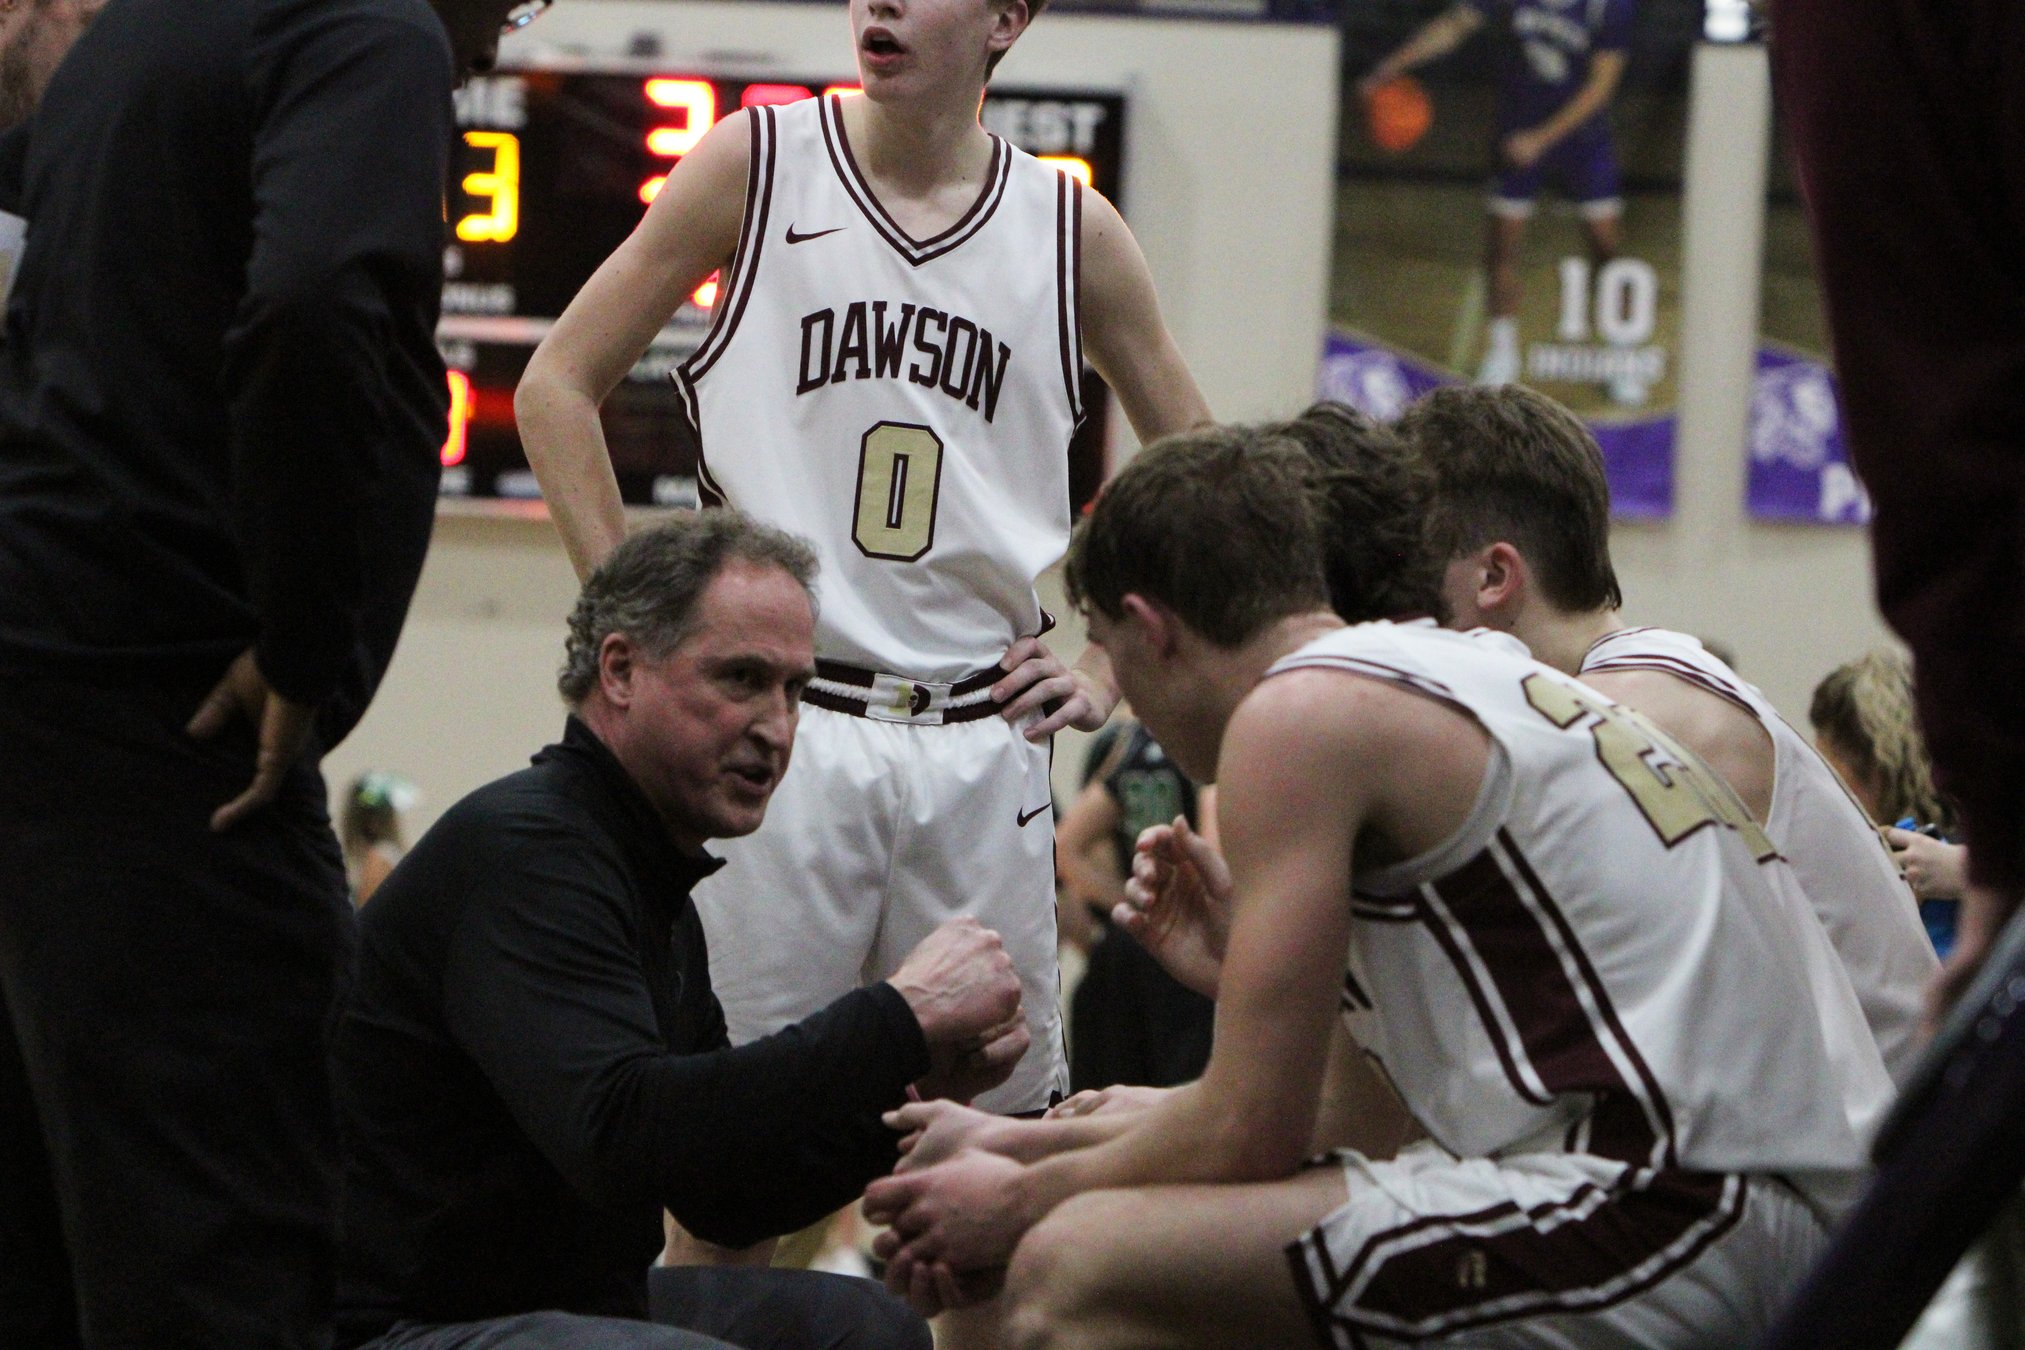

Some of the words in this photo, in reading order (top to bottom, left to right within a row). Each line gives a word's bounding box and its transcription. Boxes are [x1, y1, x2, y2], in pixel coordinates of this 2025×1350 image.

[1558, 257, 1659, 344] 10
[796, 301, 1011, 424] DAWSON
[851, 420, 944, 562] 0
